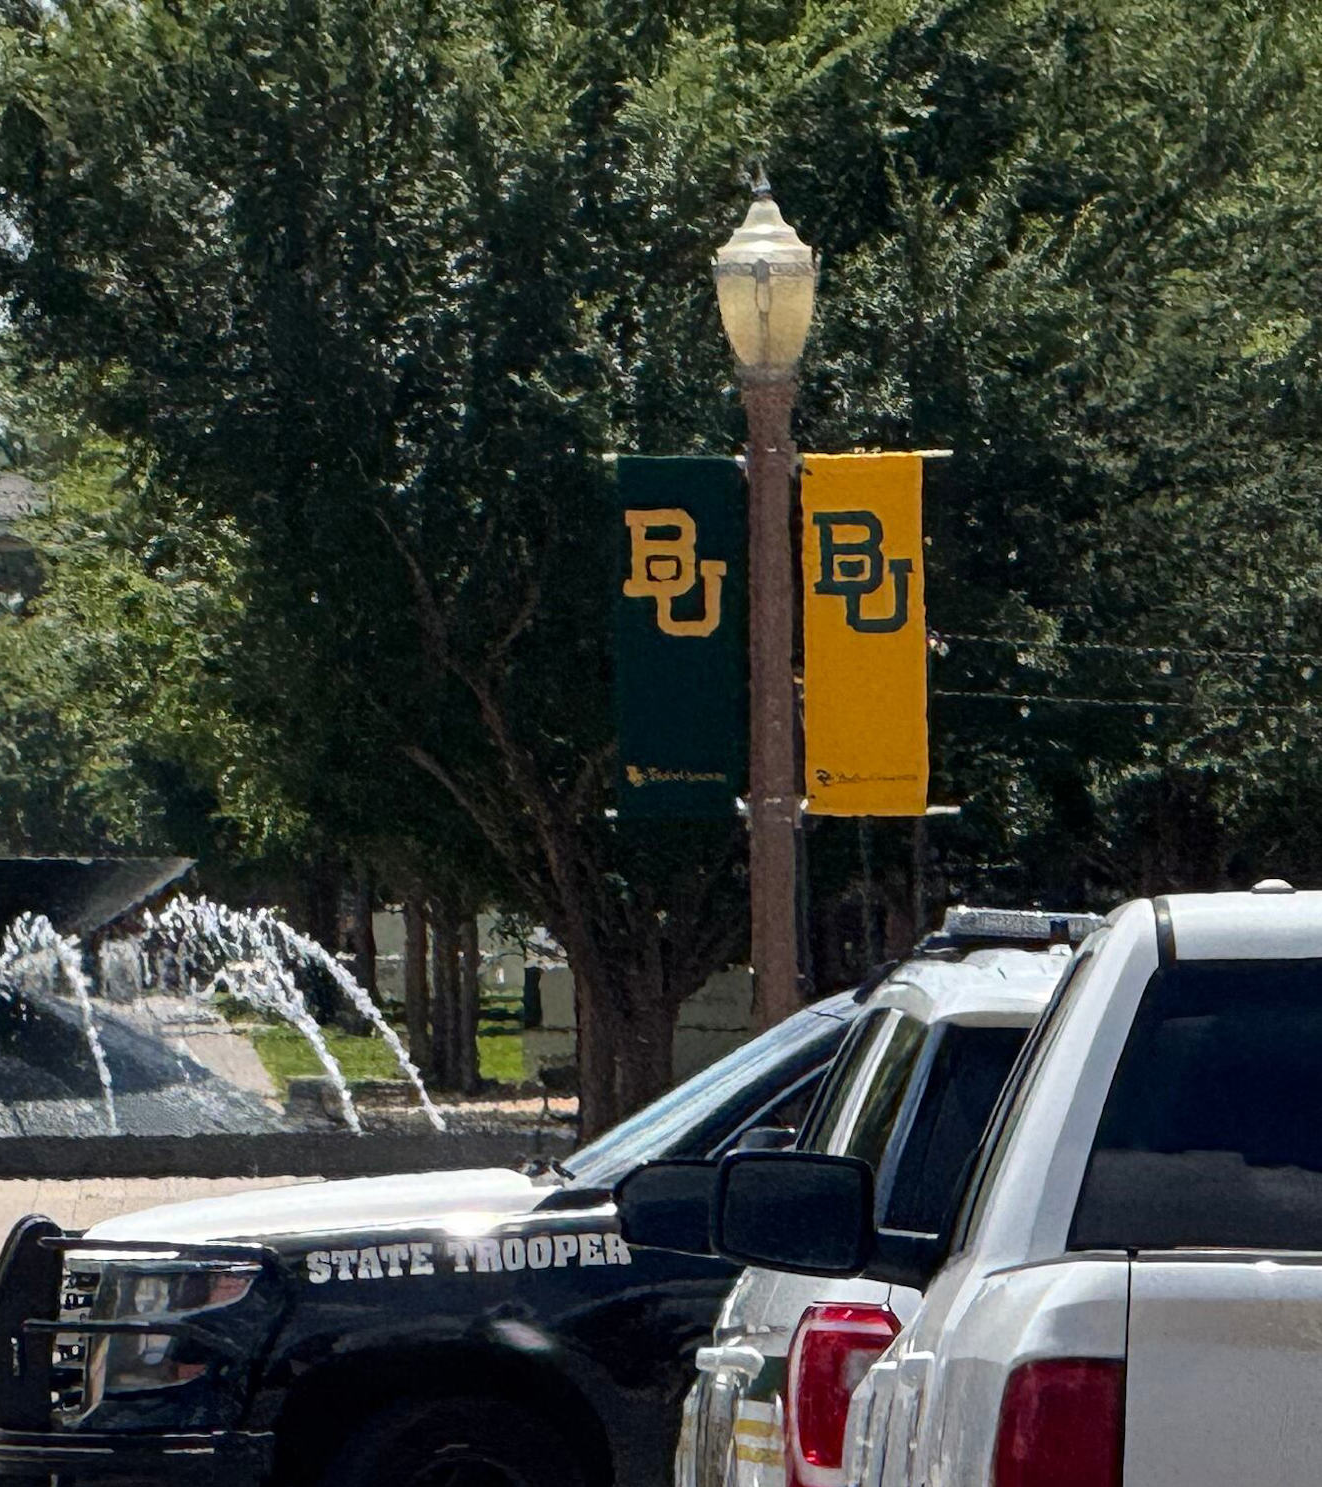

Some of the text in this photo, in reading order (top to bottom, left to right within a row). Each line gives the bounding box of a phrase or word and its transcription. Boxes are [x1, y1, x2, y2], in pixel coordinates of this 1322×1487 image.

[623, 508, 727, 637] BU
[812, 510, 914, 633] BU
[306, 1232, 632, 1284] STATE TROOPER
